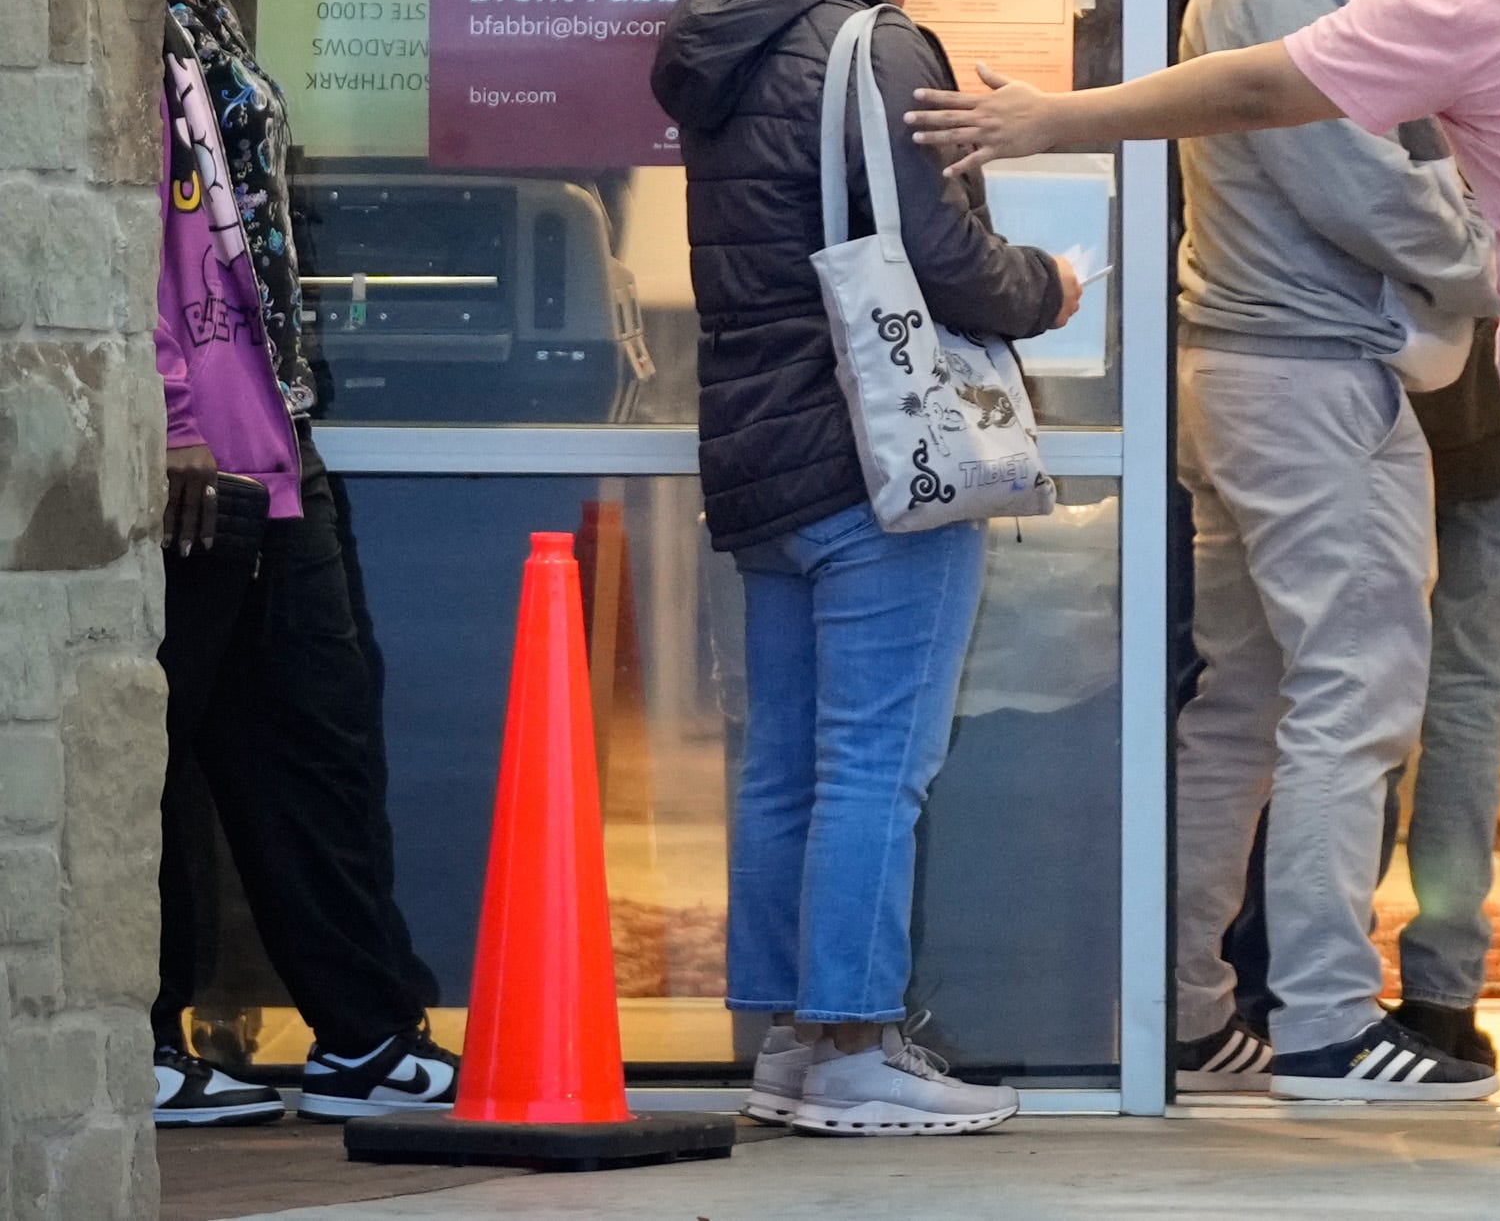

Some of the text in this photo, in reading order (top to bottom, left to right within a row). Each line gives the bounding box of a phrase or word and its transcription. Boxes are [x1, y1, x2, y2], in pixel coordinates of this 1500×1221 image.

[316, 1, 426, 20] STE C1000
[312, 38, 428, 57] MEADOWS
[470, 87, 556, 106] bigv.com
